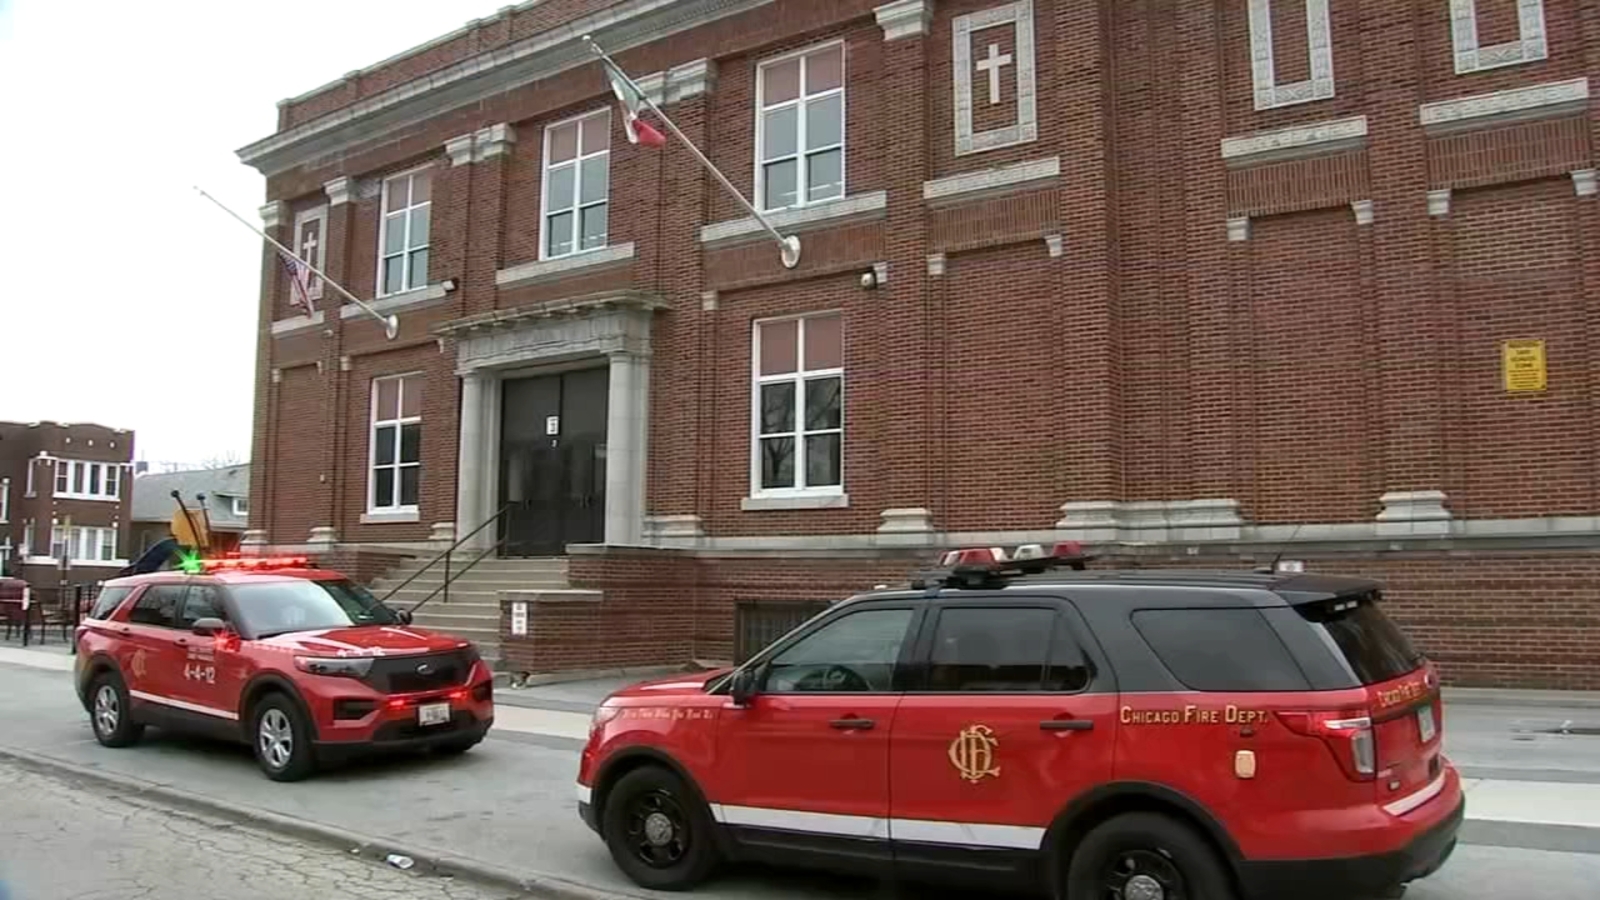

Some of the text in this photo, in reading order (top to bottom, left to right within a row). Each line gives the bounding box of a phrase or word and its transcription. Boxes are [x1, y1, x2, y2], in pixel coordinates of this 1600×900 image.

[184, 663, 216, 684] 4-4-12
[1120, 704, 1269, 724] CHICAGO FIRE DEPT.
